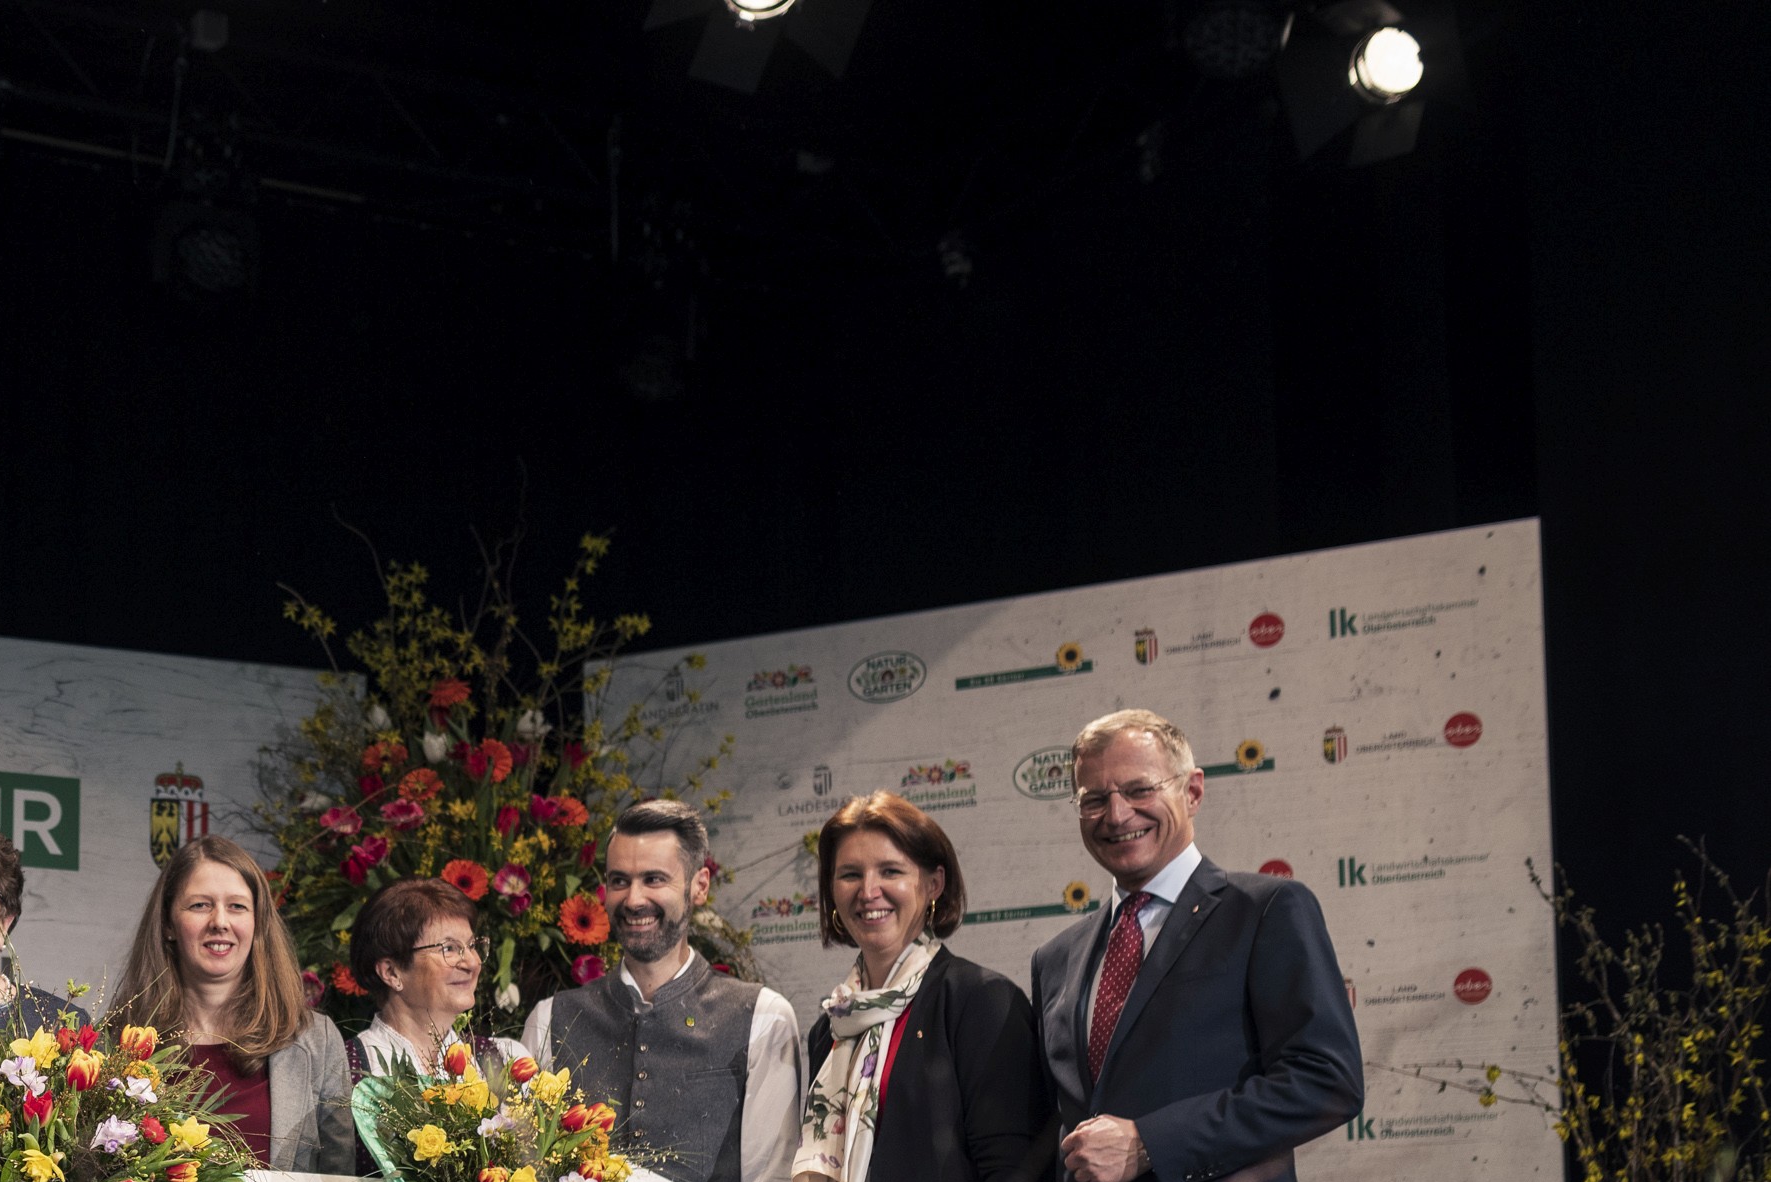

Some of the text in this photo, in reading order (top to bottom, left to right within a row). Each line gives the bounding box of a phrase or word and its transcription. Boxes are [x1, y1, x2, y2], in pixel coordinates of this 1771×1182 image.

[866, 655, 908, 671] NATUR
[863, 680, 912, 697] GARTEN
[744, 687, 818, 708] Gartenland
[1029, 781, 1071, 793] GARTE
[751, 934, 821, 945] Oberösterreic
